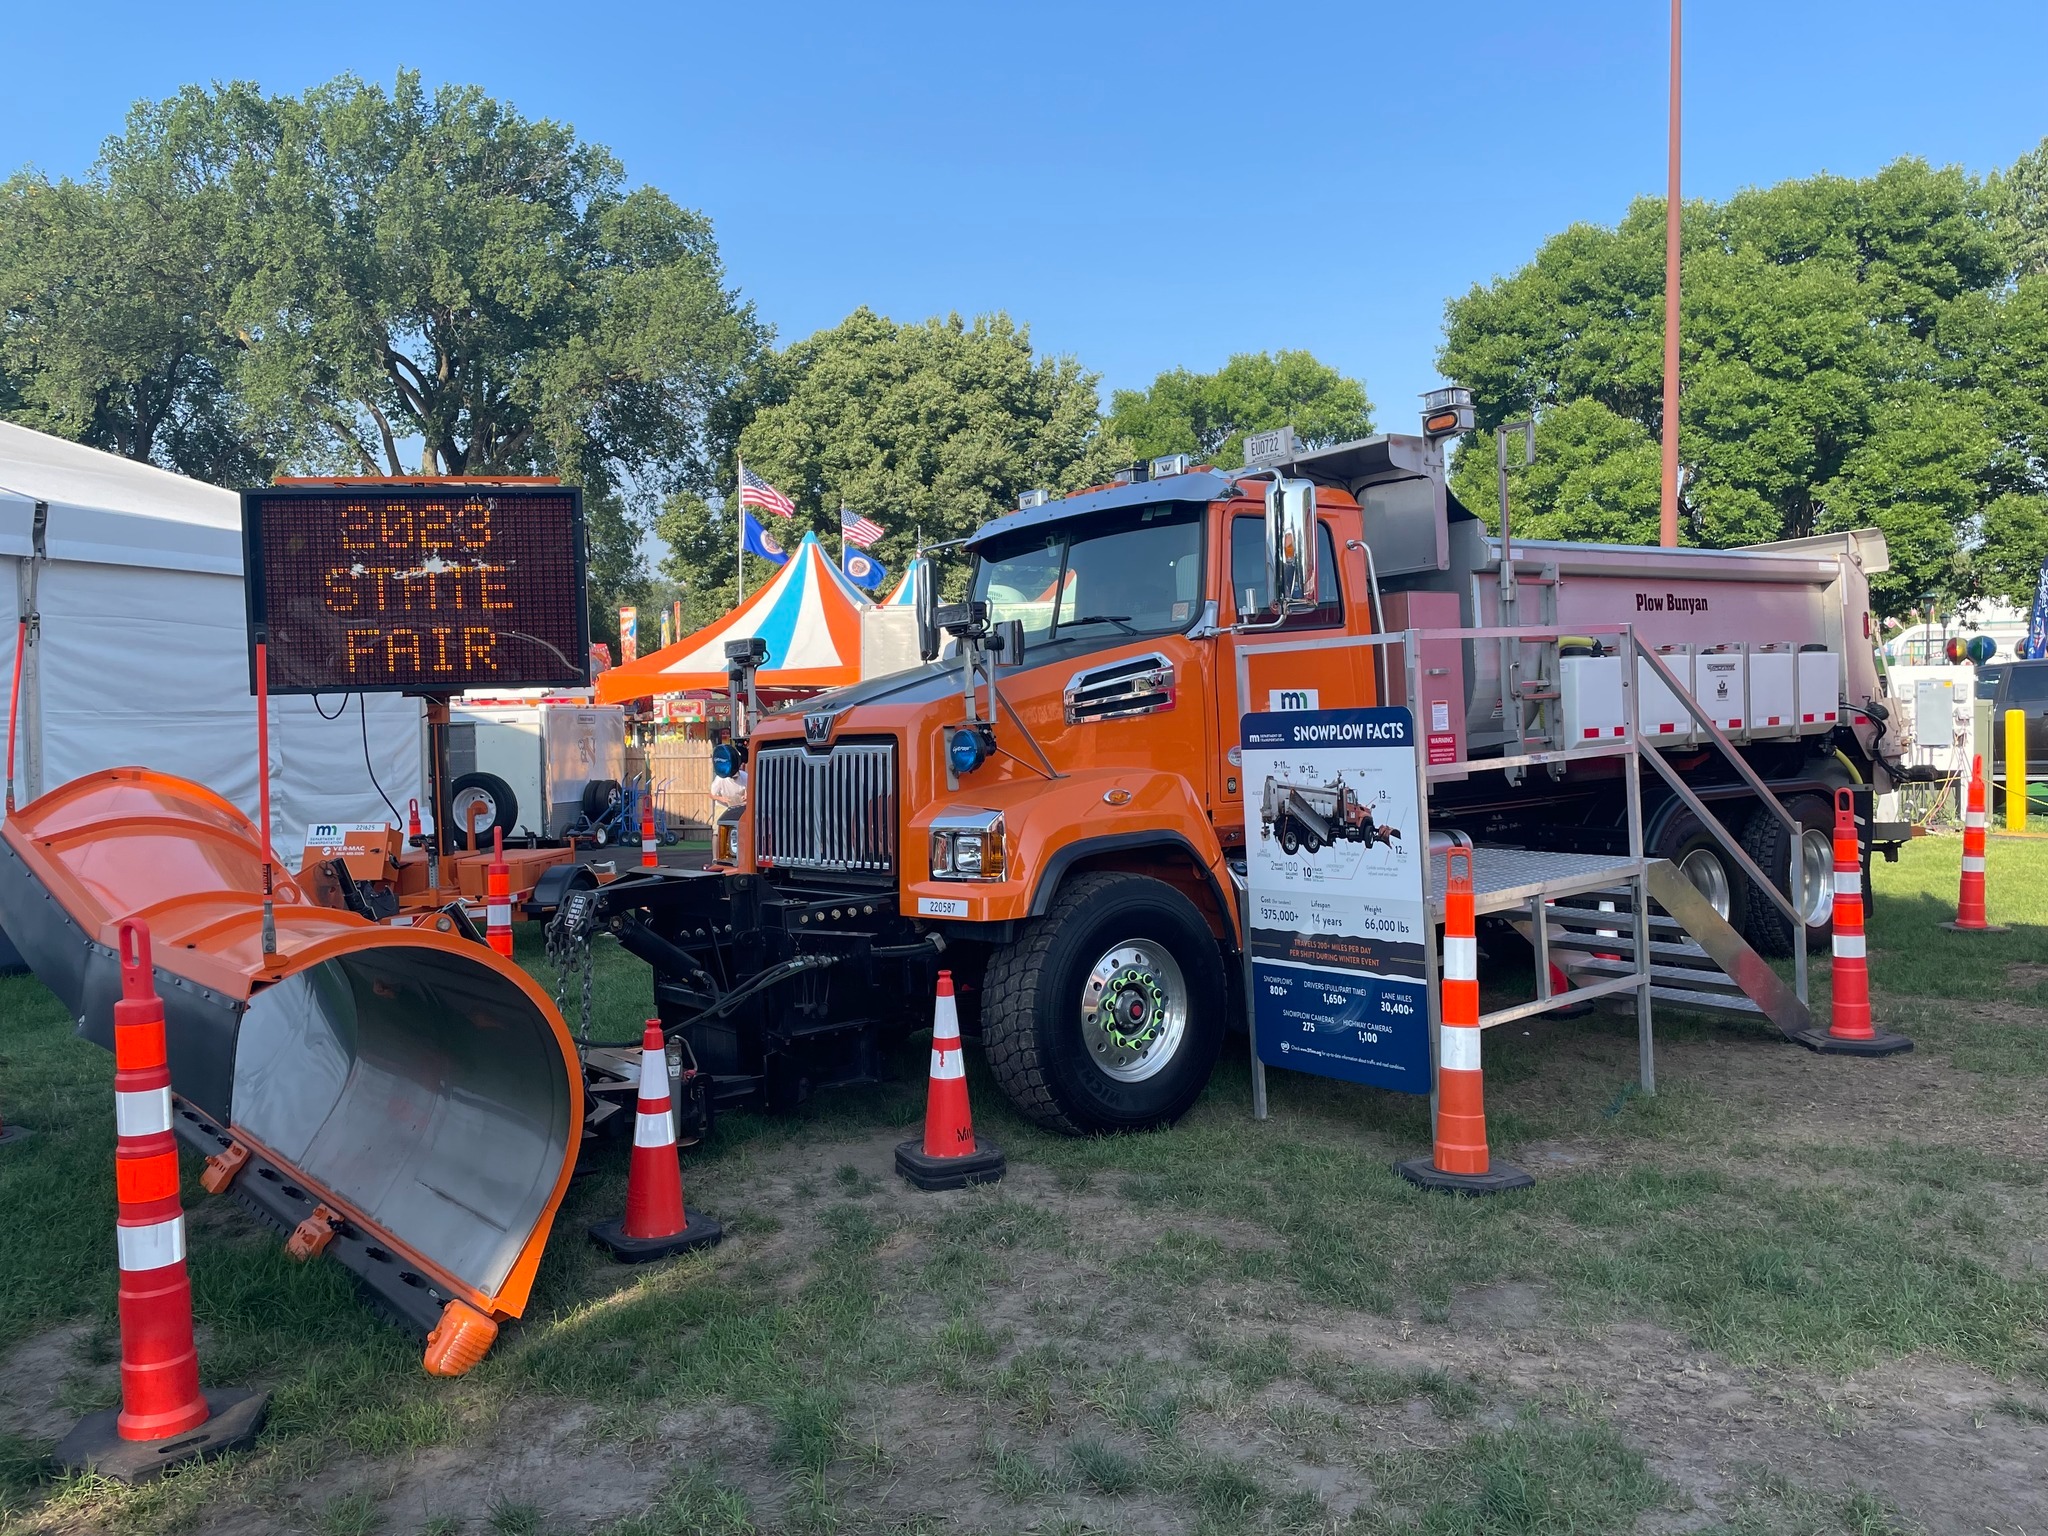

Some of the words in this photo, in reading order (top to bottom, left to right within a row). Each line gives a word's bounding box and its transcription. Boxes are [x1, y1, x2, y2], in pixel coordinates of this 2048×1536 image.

[1251, 437, 1279, 456] EU0722
[341, 504, 491, 549] 2023
[325, 566, 514, 612] STATE
[1636, 593, 1663, 611] Plow
[1667, 593, 1708, 615] Bunyan
[347, 626, 497, 673] FAIR
[1293, 724, 1364, 742] SNOWPLOW
[1366, 722, 1404, 739] FACTS
[1379, 790, 1386, 799] 13
[1285, 862, 1298, 872] 100
[1303, 867, 1312, 878] 10
[930, 901, 956, 913] 220587
[1260, 896, 1271, 904] Cost
[1311, 900, 1331, 910] Lifespan
[1260, 907, 1299, 922] $375,000+
[1364, 904, 1382, 915] Weight
[1311, 913, 1320, 924] 14
[1322, 918, 1343, 929] years
[1365, 918, 1395, 933] 66,000
[1397, 920, 1410, 933] lbs
[1294, 939, 1317, 949] TRAVELS
[1331, 943, 1348, 952] MILES
[1348, 945, 1359, 954] PER
[1360, 946, 1372, 955] DAY
[1289, 949, 1300, 957] PER
[1300, 950, 1315, 959] SHIFT
[1316, 952, 1338, 962] DURING
[1339, 955, 1360, 964] WINTER
[1361, 957, 1380, 967] EVENT
[1263, 975, 1294, 986] SNOWPLOWS
[1269, 985, 1287, 996] 800+
[1303, 980, 1324, 991] DRIVERS
[1352, 987, 1367, 997] TIME)
[1322, 993, 1347, 1005] 1,650+
[1381, 992, 1396, 1001] LANE
[1396, 993, 1412, 1003] MILES
[1380, 1001, 1414, 1015] 30,400+
[1282, 1009, 1310, 1020] SNOWPLOW
[1310, 1013, 1335, 1024] CAMERAS
[1302, 1021, 1316, 1033] 275
[1342, 1019, 1366, 1029] HIGHWAY
[1367, 1022, 1393, 1034] CAMERAS
[1357, 1031, 1378, 1044] 1,100
